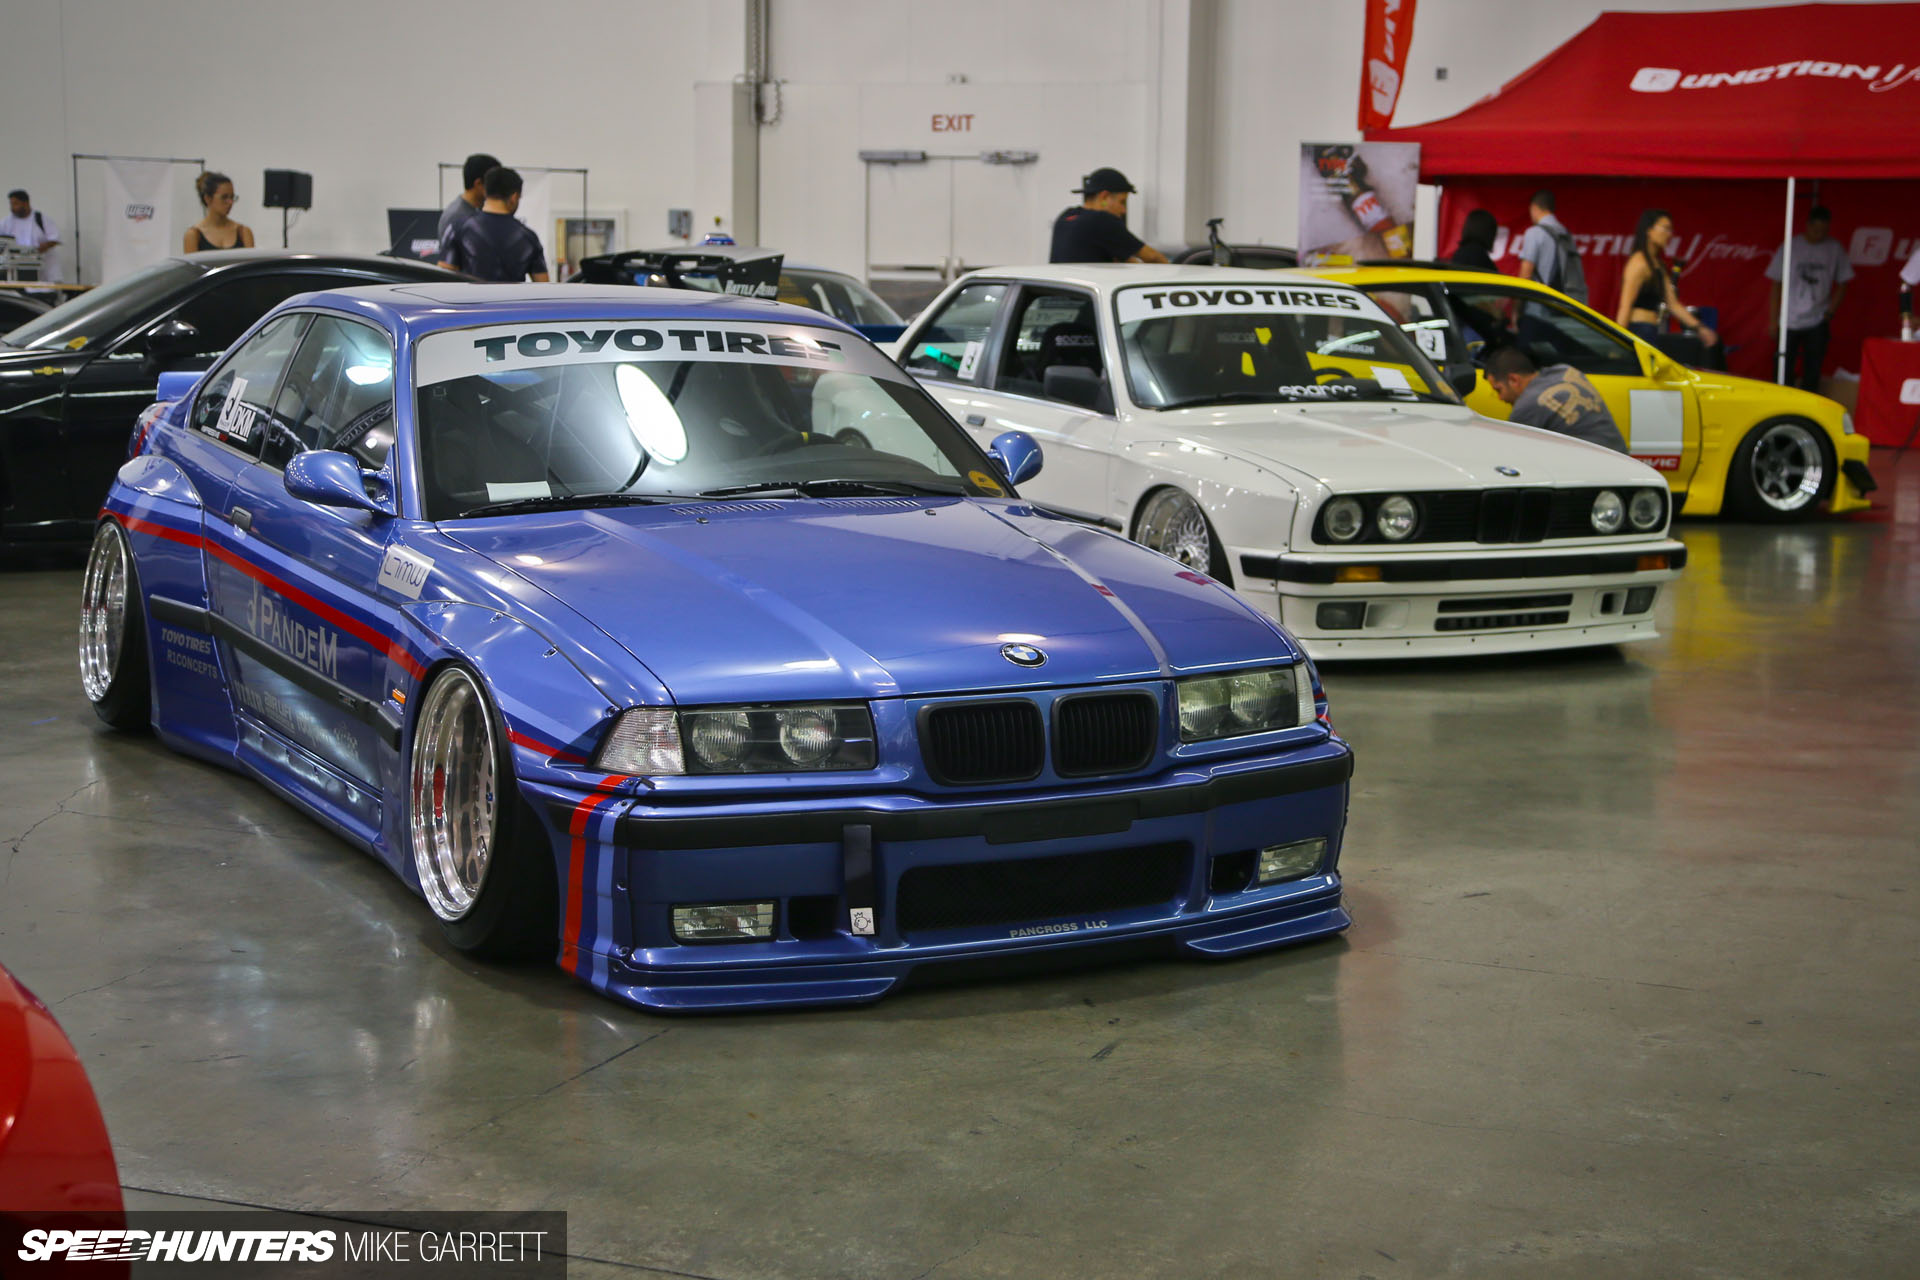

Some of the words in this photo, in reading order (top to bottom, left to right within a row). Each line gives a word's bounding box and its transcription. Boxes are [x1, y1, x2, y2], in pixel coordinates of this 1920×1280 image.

[931, 113, 977, 132] EXIT
[1009, 922, 1079, 938] PANCROSS
[1084, 920, 1109, 930] LLC
